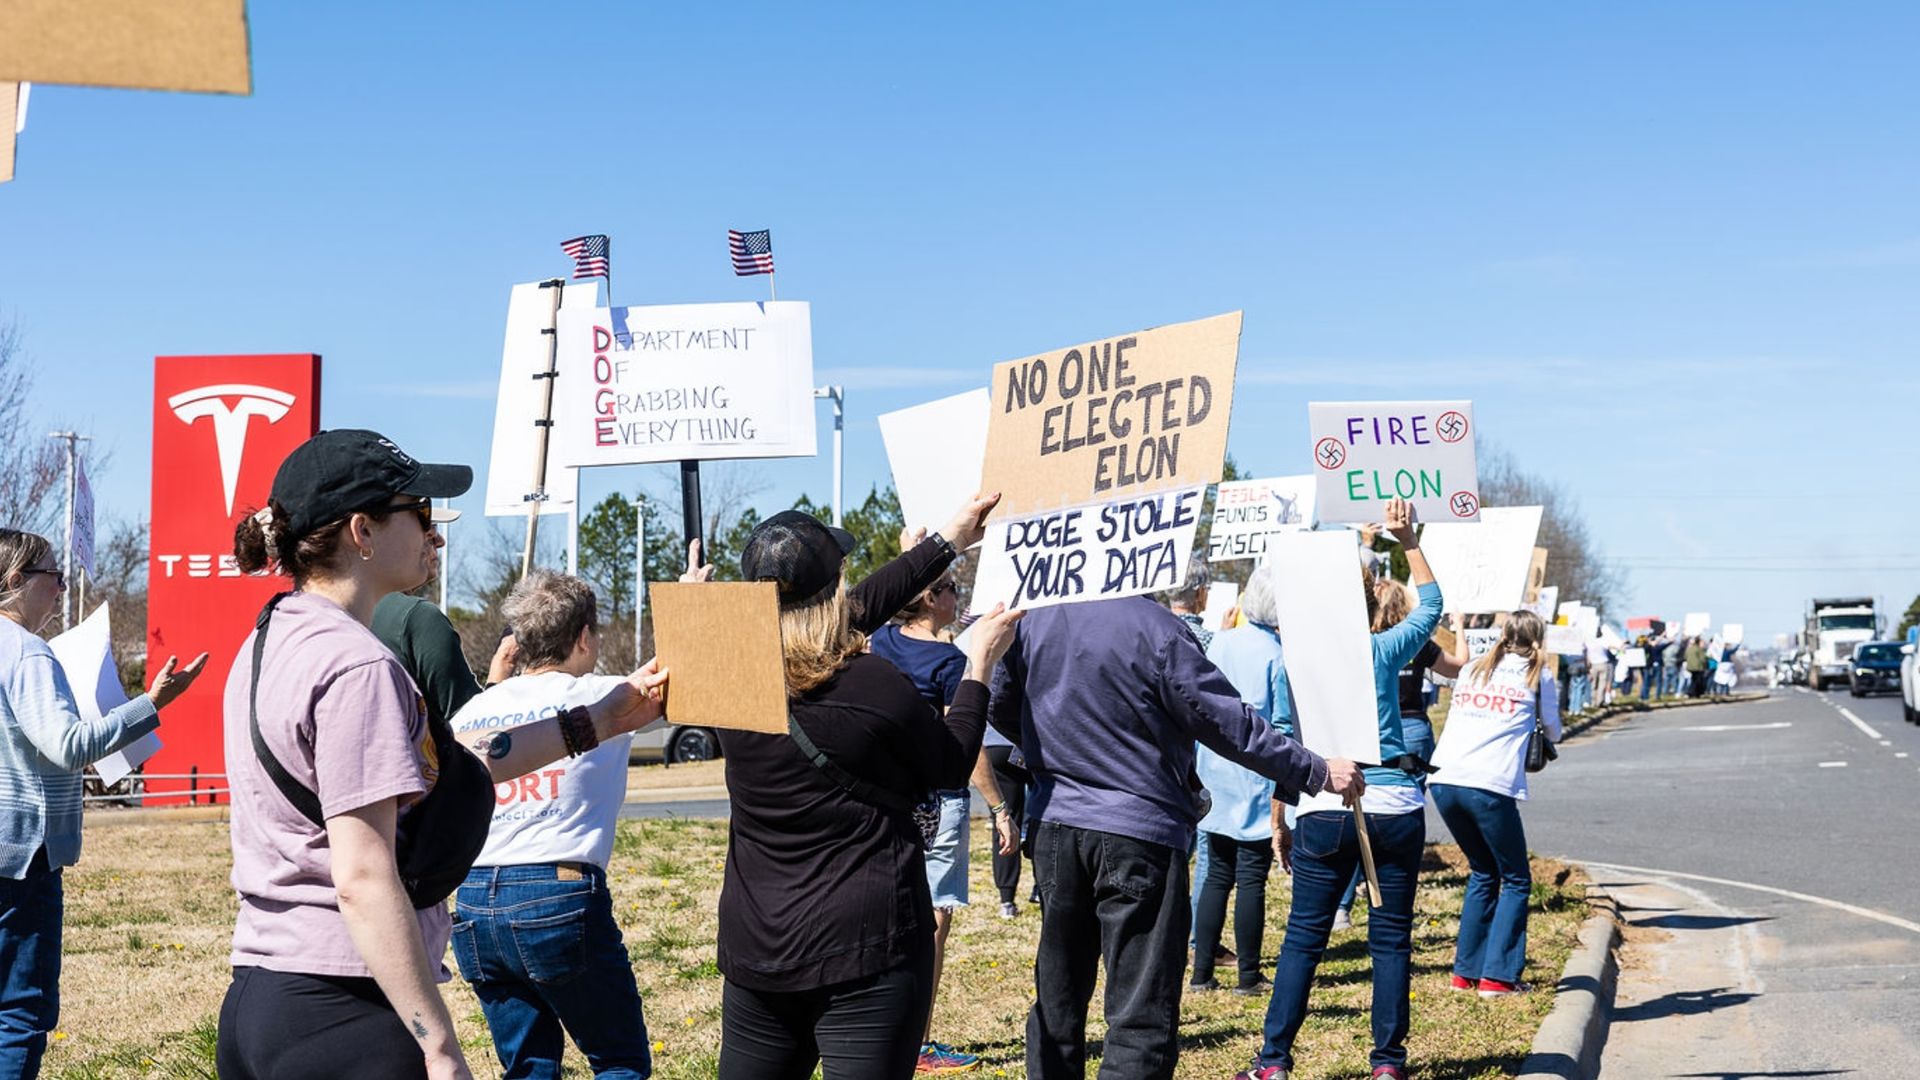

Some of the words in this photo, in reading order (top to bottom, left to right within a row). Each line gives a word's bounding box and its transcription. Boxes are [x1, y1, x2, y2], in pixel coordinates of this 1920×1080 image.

[592, 325, 756, 353] DEPARTMENT
[594, 354, 630, 384] OF
[1005, 359, 1048, 413] NO
[1058, 337, 1137, 400] ONE
[595, 385, 730, 416] GRABBING
[1040, 375, 1212, 456] ELECTED
[594, 416, 757, 446] EVERYTHING
[1347, 415, 1431, 445] FIRE
[1094, 433, 1180, 493] ELON
[1220, 486, 1268, 503] TESLA
[1347, 469, 1441, 500] ELON
[1004, 511, 1082, 552] DOGE
[1097, 491, 1198, 543] STOLE
[1215, 505, 1268, 523] FUNDS
[1209, 531, 1281, 557] FASCI
[157, 554, 284, 578] TES
[1010, 550, 1087, 610] YOUR
[1101, 538, 1177, 593] DATA
[495, 768, 565, 805] ORT
